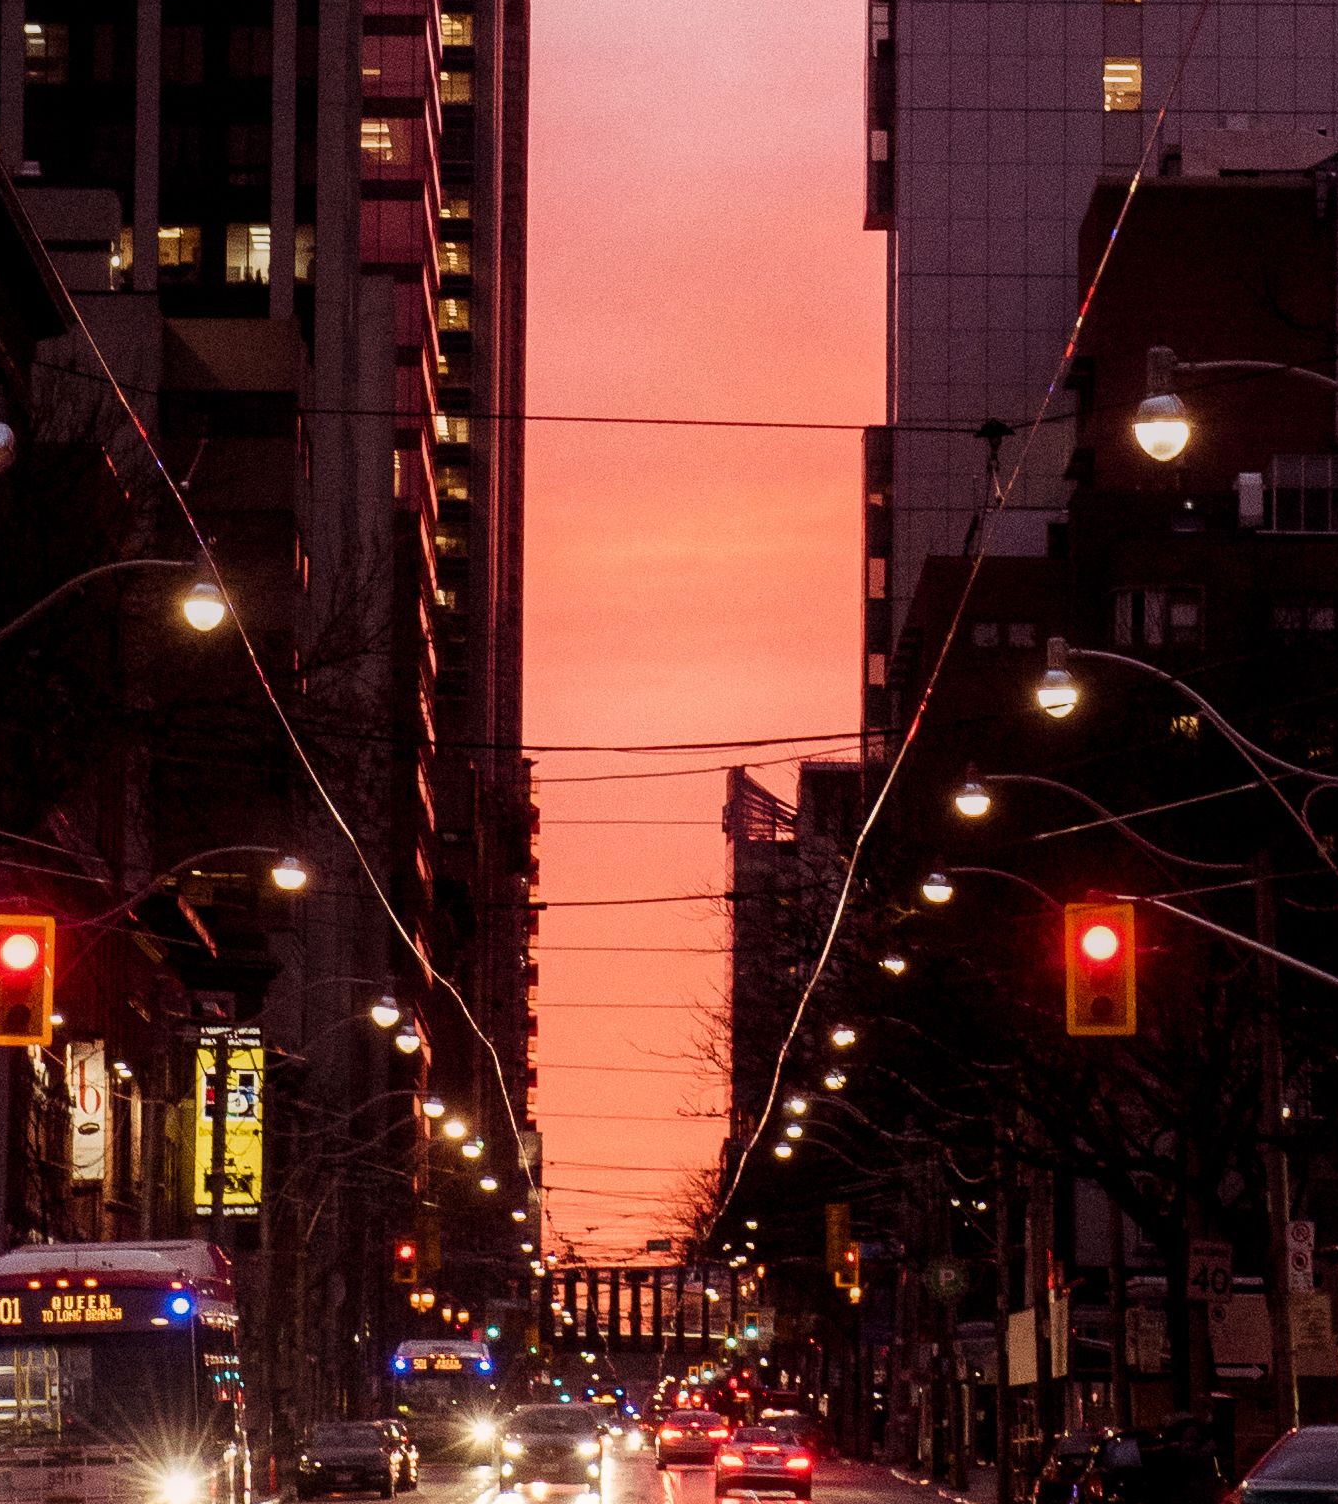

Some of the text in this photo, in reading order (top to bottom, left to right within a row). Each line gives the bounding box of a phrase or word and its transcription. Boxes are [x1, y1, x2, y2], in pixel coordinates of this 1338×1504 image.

[1192, 1264, 1228, 1293] 40
[50, 1293, 112, 1311] QUEEN
[41, 1307, 123, 1324] TO LONG BRANCH
